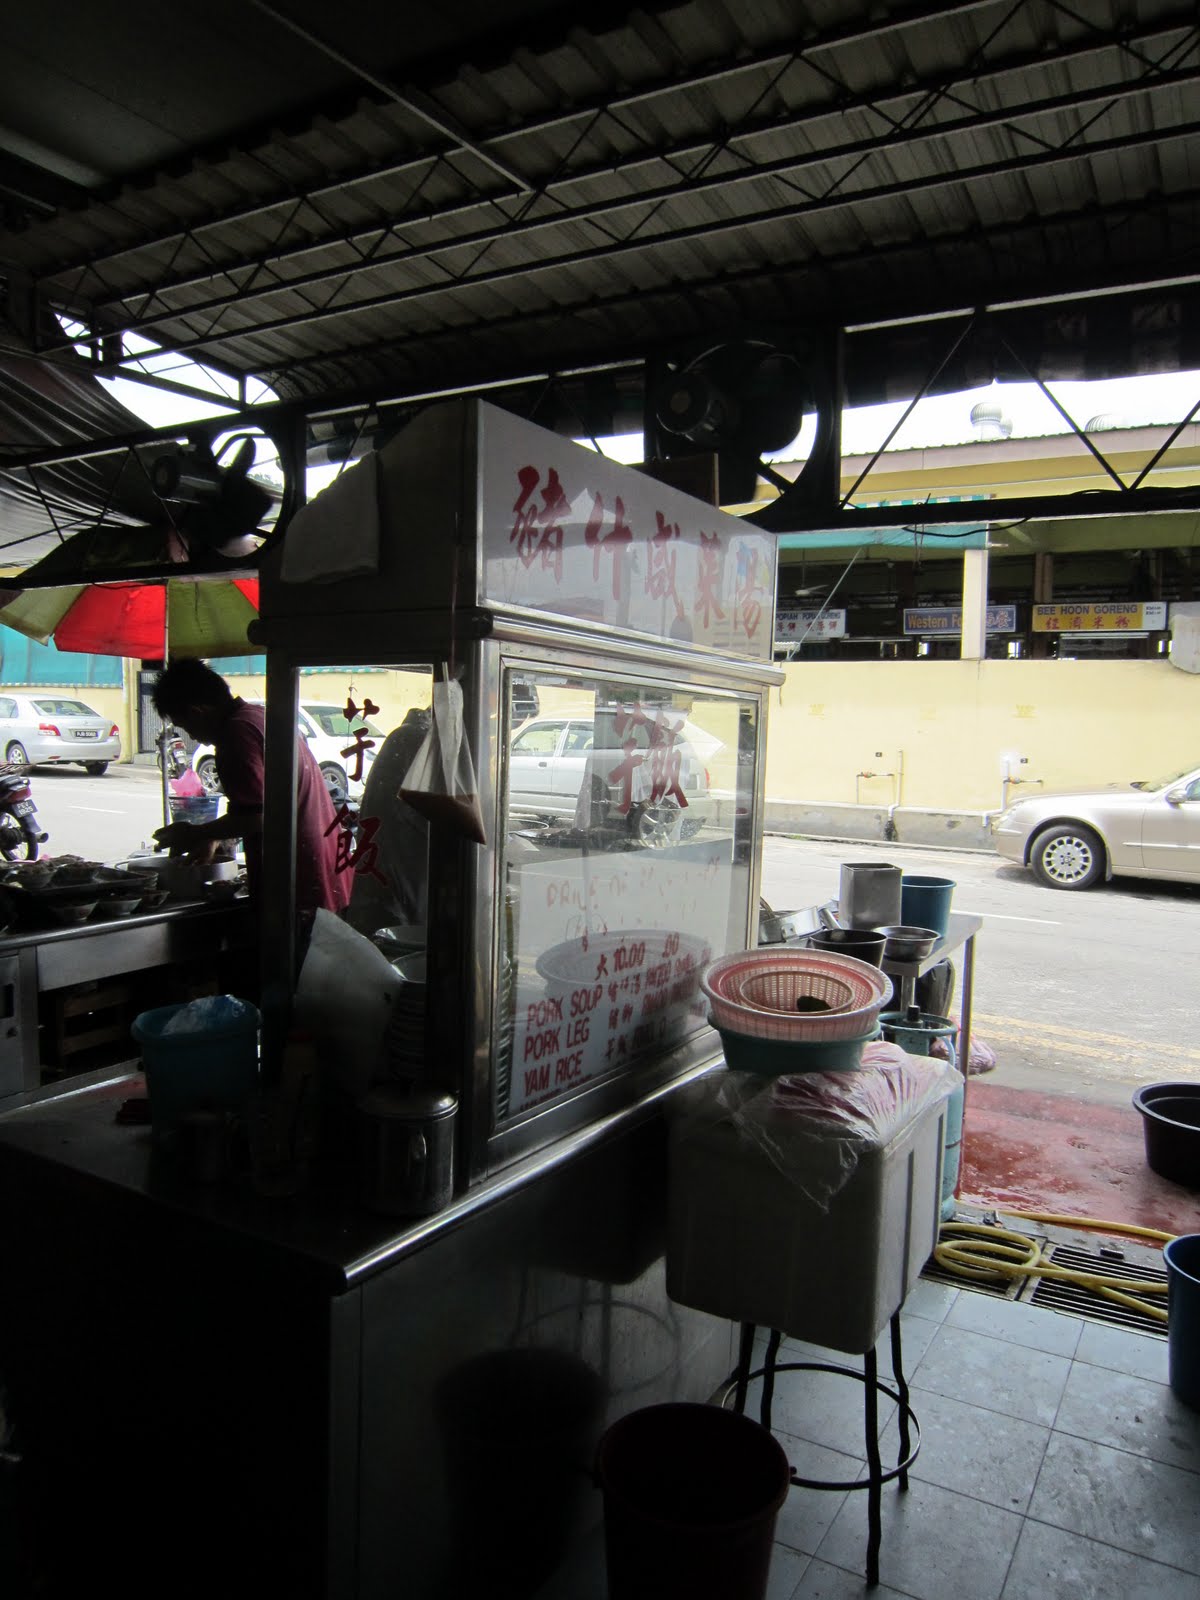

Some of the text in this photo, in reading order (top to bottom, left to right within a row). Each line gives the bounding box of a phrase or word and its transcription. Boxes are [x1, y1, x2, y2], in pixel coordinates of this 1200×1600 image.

[908, 614, 963, 629] Western Fo
[1037, 606, 1056, 616] BEE
[1060, 605, 1089, 615] HOON
[1094, 604, 1138, 614] GORENG
[526, 996, 564, 1031] PORK
[569, 984, 603, 1018] SOUP
[524, 1026, 561, 1063] PORK
[566, 1016, 590, 1049] LEG
[524, 1063, 551, 1097] YAM
[555, 1050, 584, 1085] RICE
